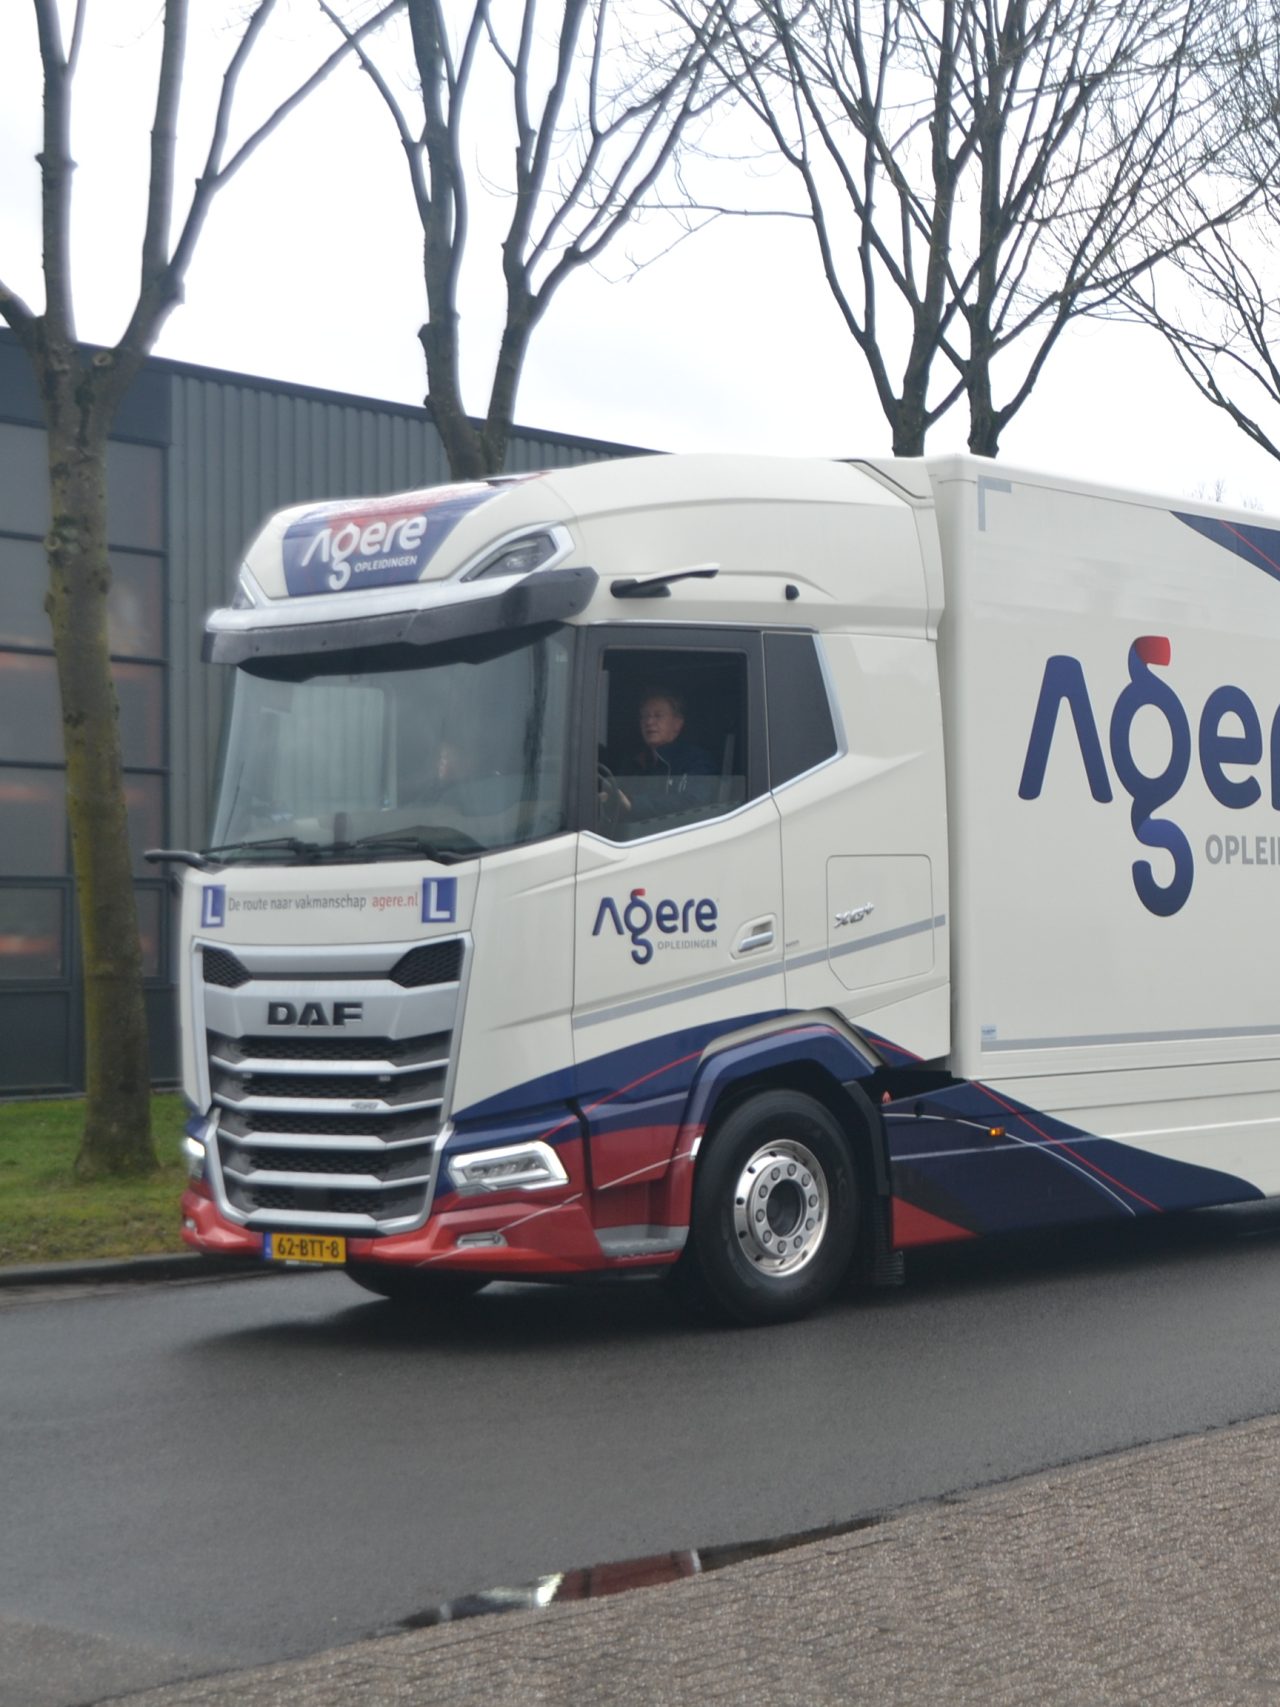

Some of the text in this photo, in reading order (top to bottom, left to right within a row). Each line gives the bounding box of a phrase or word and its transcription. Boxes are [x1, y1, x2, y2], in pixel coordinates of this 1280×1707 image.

[301, 516, 427, 591] Agere
[354, 556, 418, 573] OPLEIDINGEN
[206, 888, 221, 925] L
[228, 892, 418, 912] De route naar vakmanschap agere.nl
[429, 881, 451, 919] L
[592, 888, 718, 965] Agere
[657, 939, 718, 951] OPLEIDINGEN
[267, 1002, 363, 1027] DAF
[278, 1236, 339, 1258] 62-BTT-8
